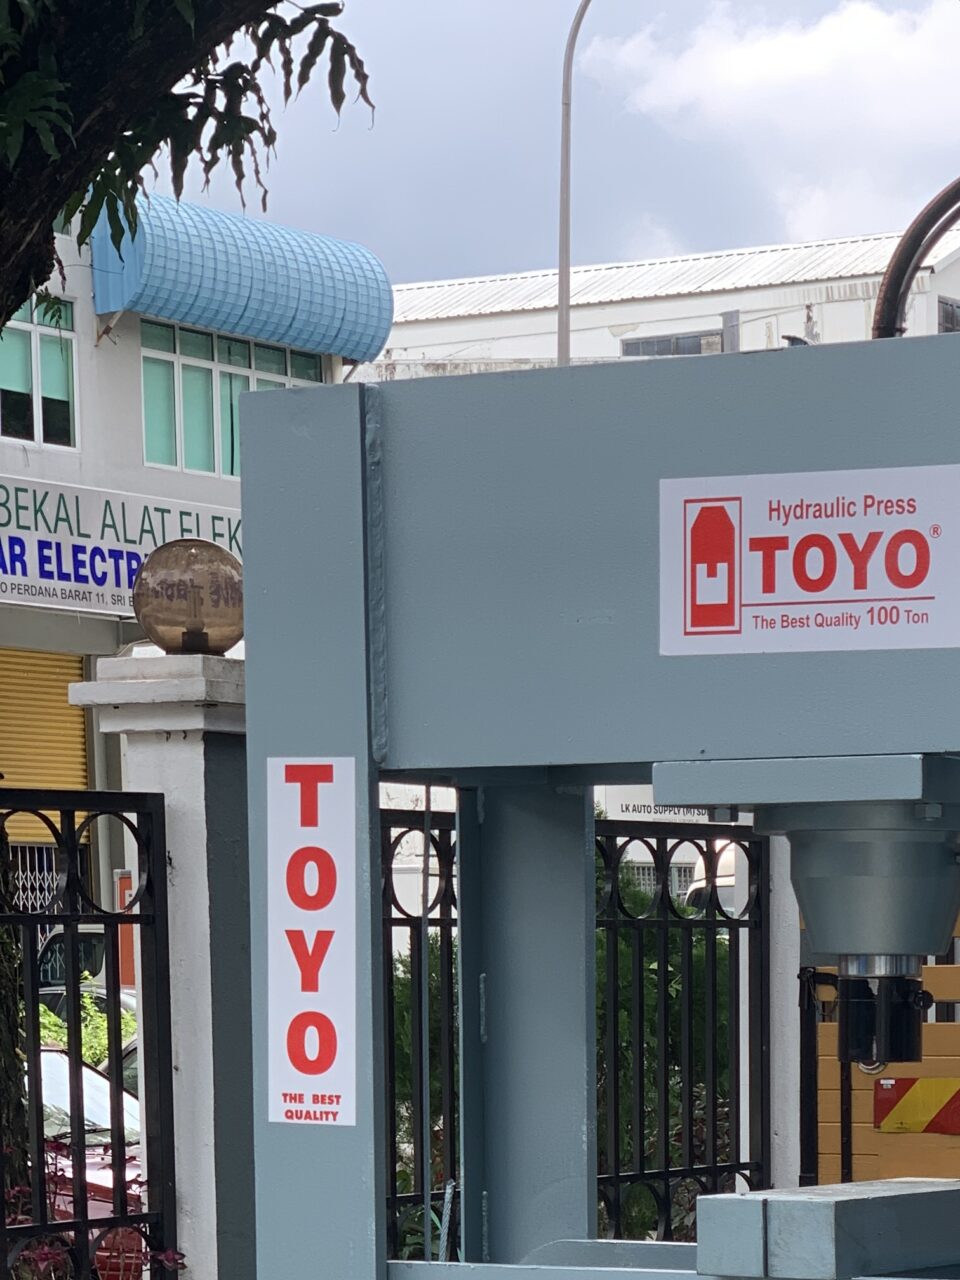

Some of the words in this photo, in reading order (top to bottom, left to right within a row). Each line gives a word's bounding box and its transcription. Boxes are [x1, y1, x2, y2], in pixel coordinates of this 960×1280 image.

[768, 497, 856, 526] Hydraulic
[863, 494, 917, 516] Press
[100, 499, 171, 547] ALAT
[37, 539, 149, 590] ELECTR
[10, 582, 58, 599] PERDANA
[60, 588, 93, 603] BARAT
[110, 593, 126, 607] SRI
[752, 614, 777, 630] The
[780, 613, 810, 629] Best
[814, 610, 861, 630] Quality
[866, 605, 900, 626] 100
[904, 607, 929, 624] Ton
[620, 803, 631, 814] LK
[632, 804, 652, 815] AUTO
[653, 804, 681, 817] SUPPLY
[284, 763, 338, 1076] TOYO
[282, 1091, 305, 1105] THE
[312, 1093, 342, 1106] BEST
[284, 1108, 339, 1122] QUALITY
